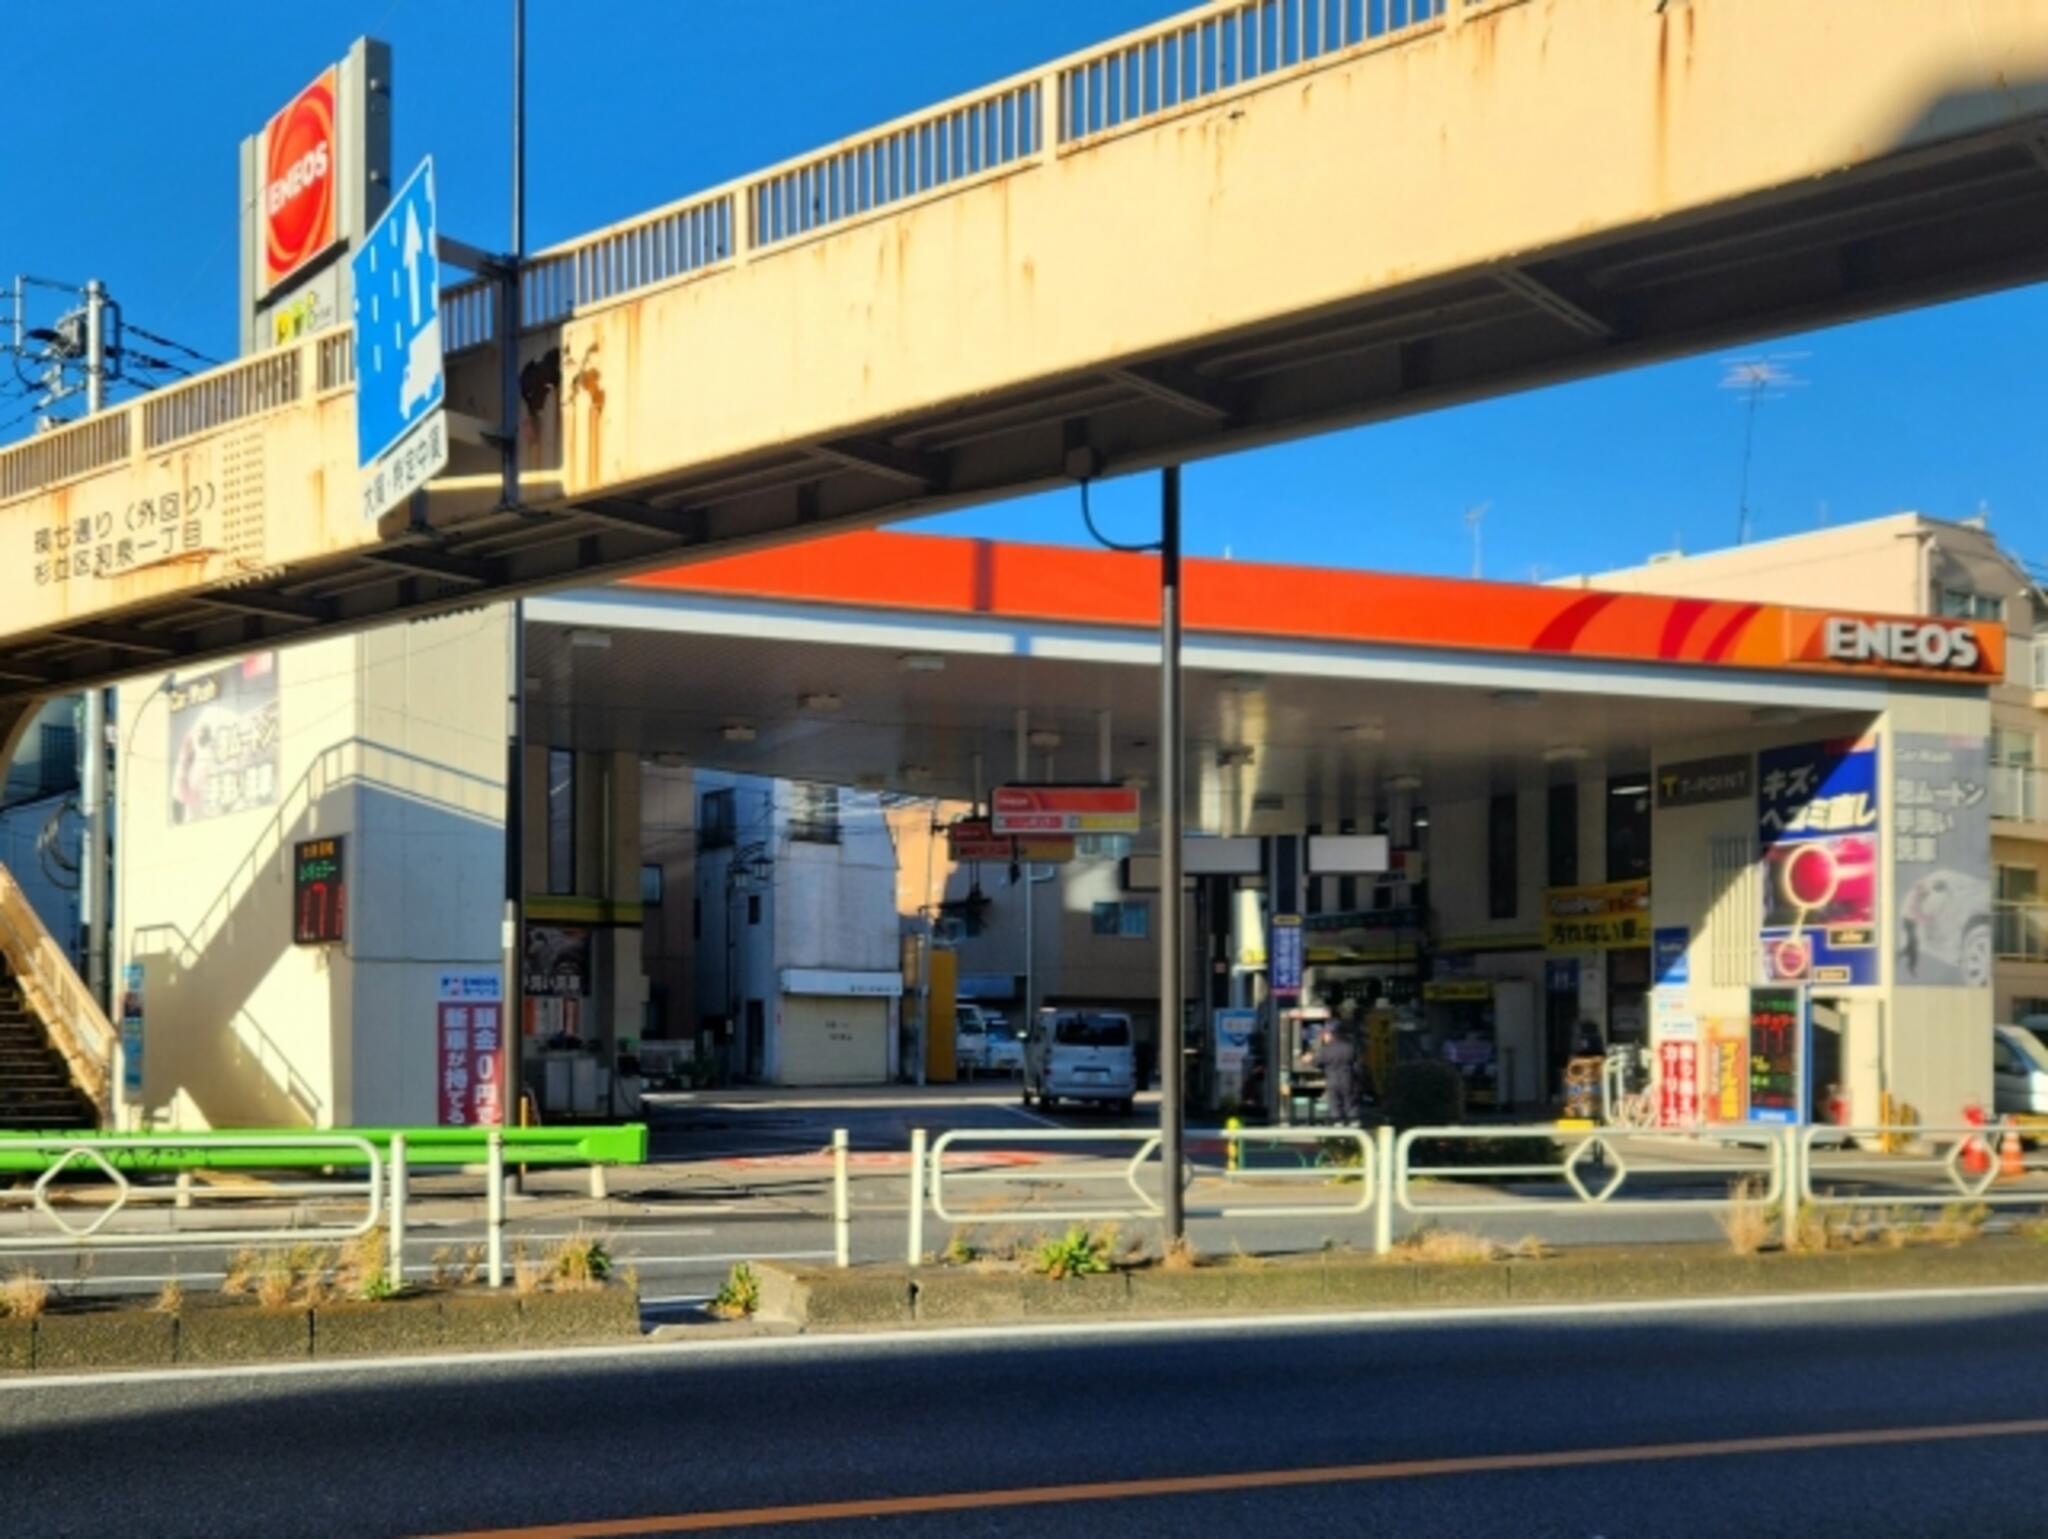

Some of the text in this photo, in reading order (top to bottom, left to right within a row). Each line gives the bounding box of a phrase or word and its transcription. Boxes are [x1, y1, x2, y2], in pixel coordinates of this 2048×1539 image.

[267, 141, 328, 217] ENEOS
[34, 520, 202, 586] 杉並区和泉一丁目
[1824, 617, 1978, 668] ENEOS
[1680, 770, 1748, 795] T-POINT
